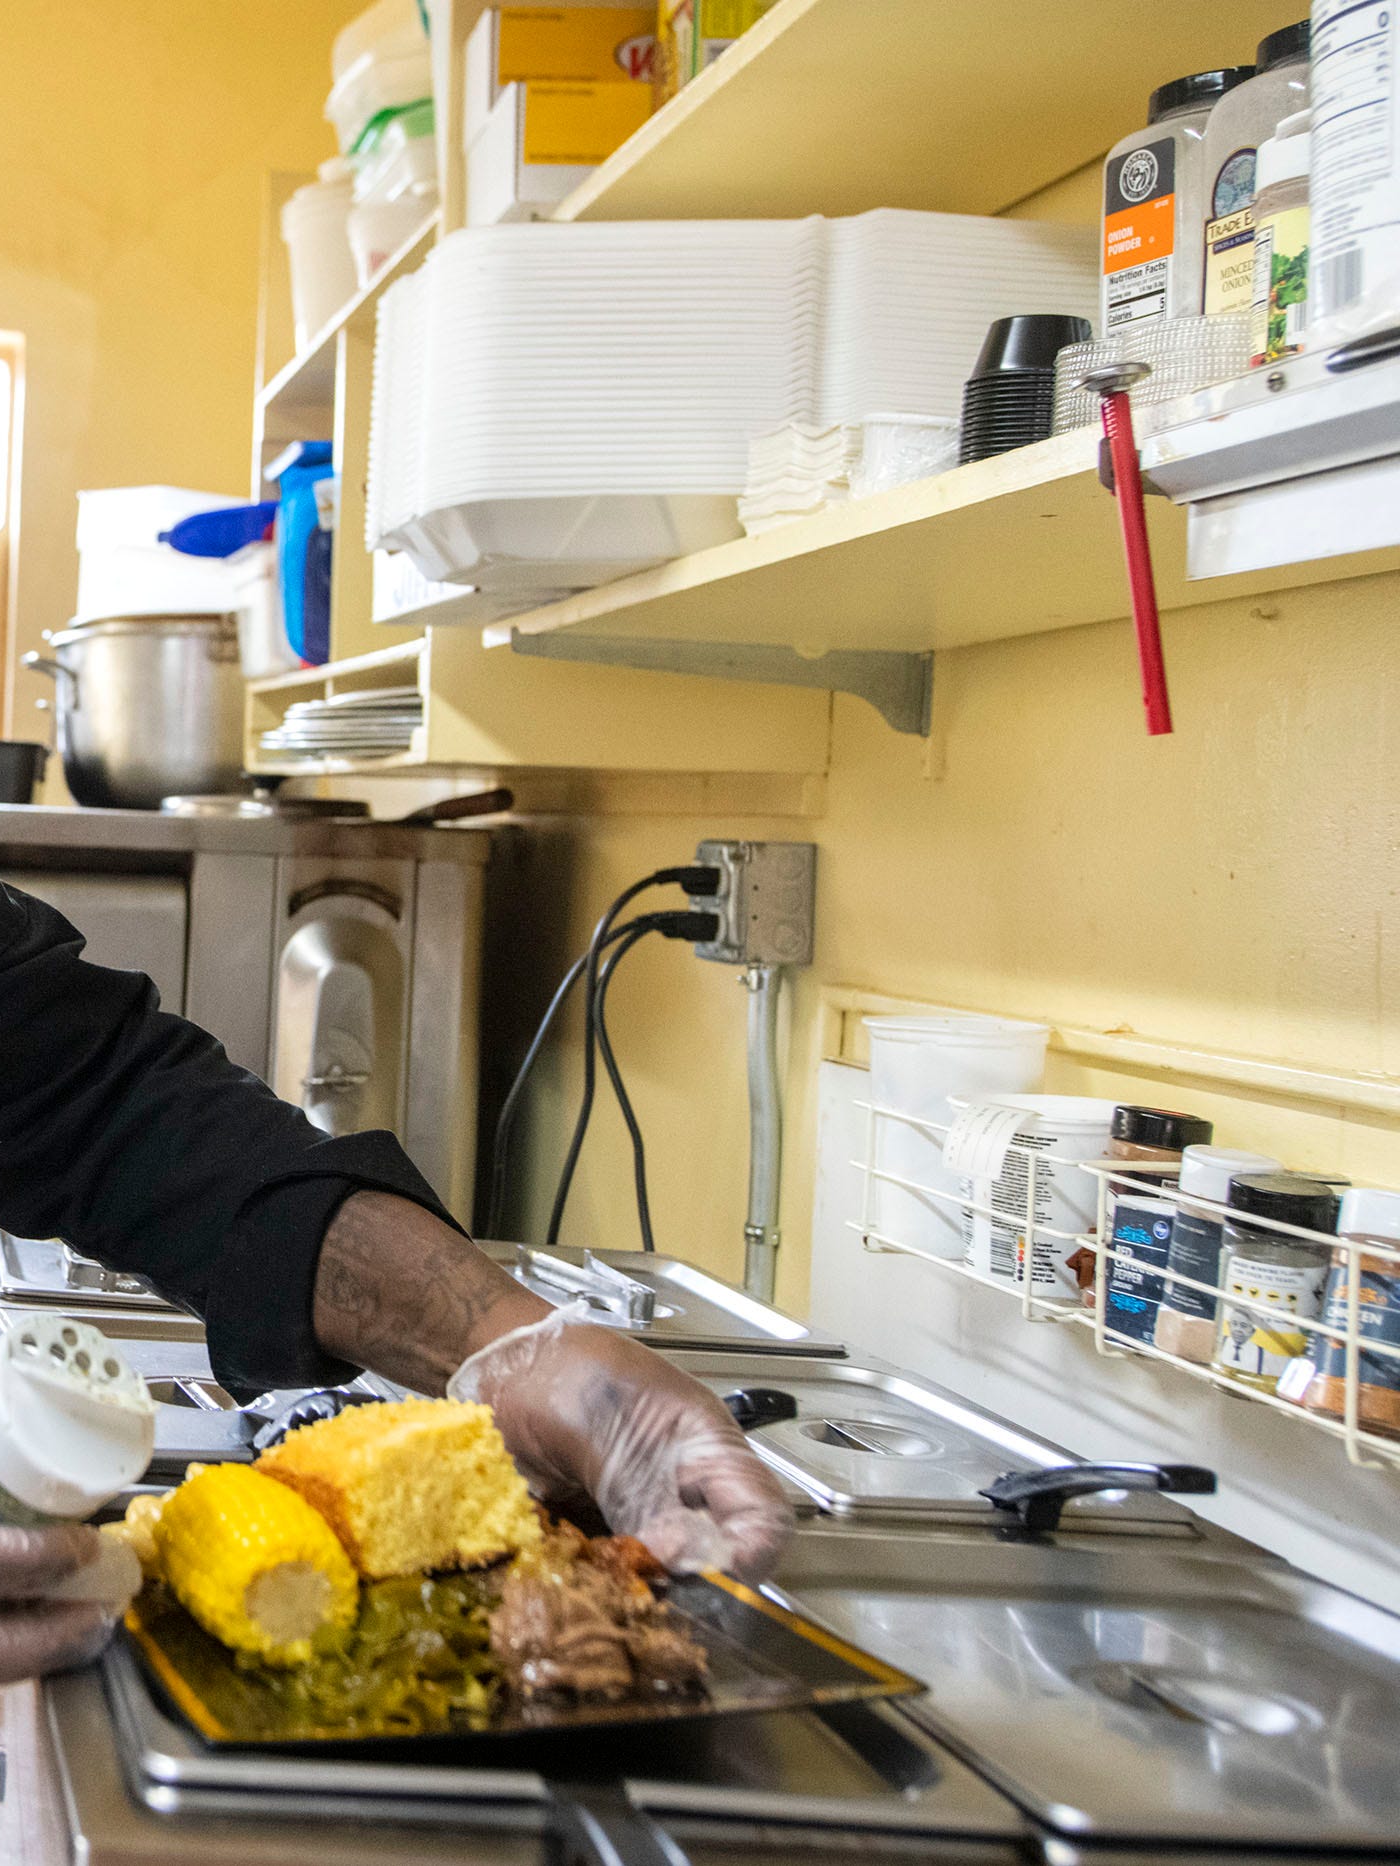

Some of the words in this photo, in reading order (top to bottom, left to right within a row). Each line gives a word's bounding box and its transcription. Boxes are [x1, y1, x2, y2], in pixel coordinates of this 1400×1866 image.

[1108, 226, 1134, 244] ONION
[1207, 218, 1241, 239] TRADE
[1108, 236, 1142, 256] POWDER
[1109, 269, 1143, 285] Nutrition
[1145, 262, 1167, 275] Facts
[1113, 1267, 1144, 1286] PEPPER
